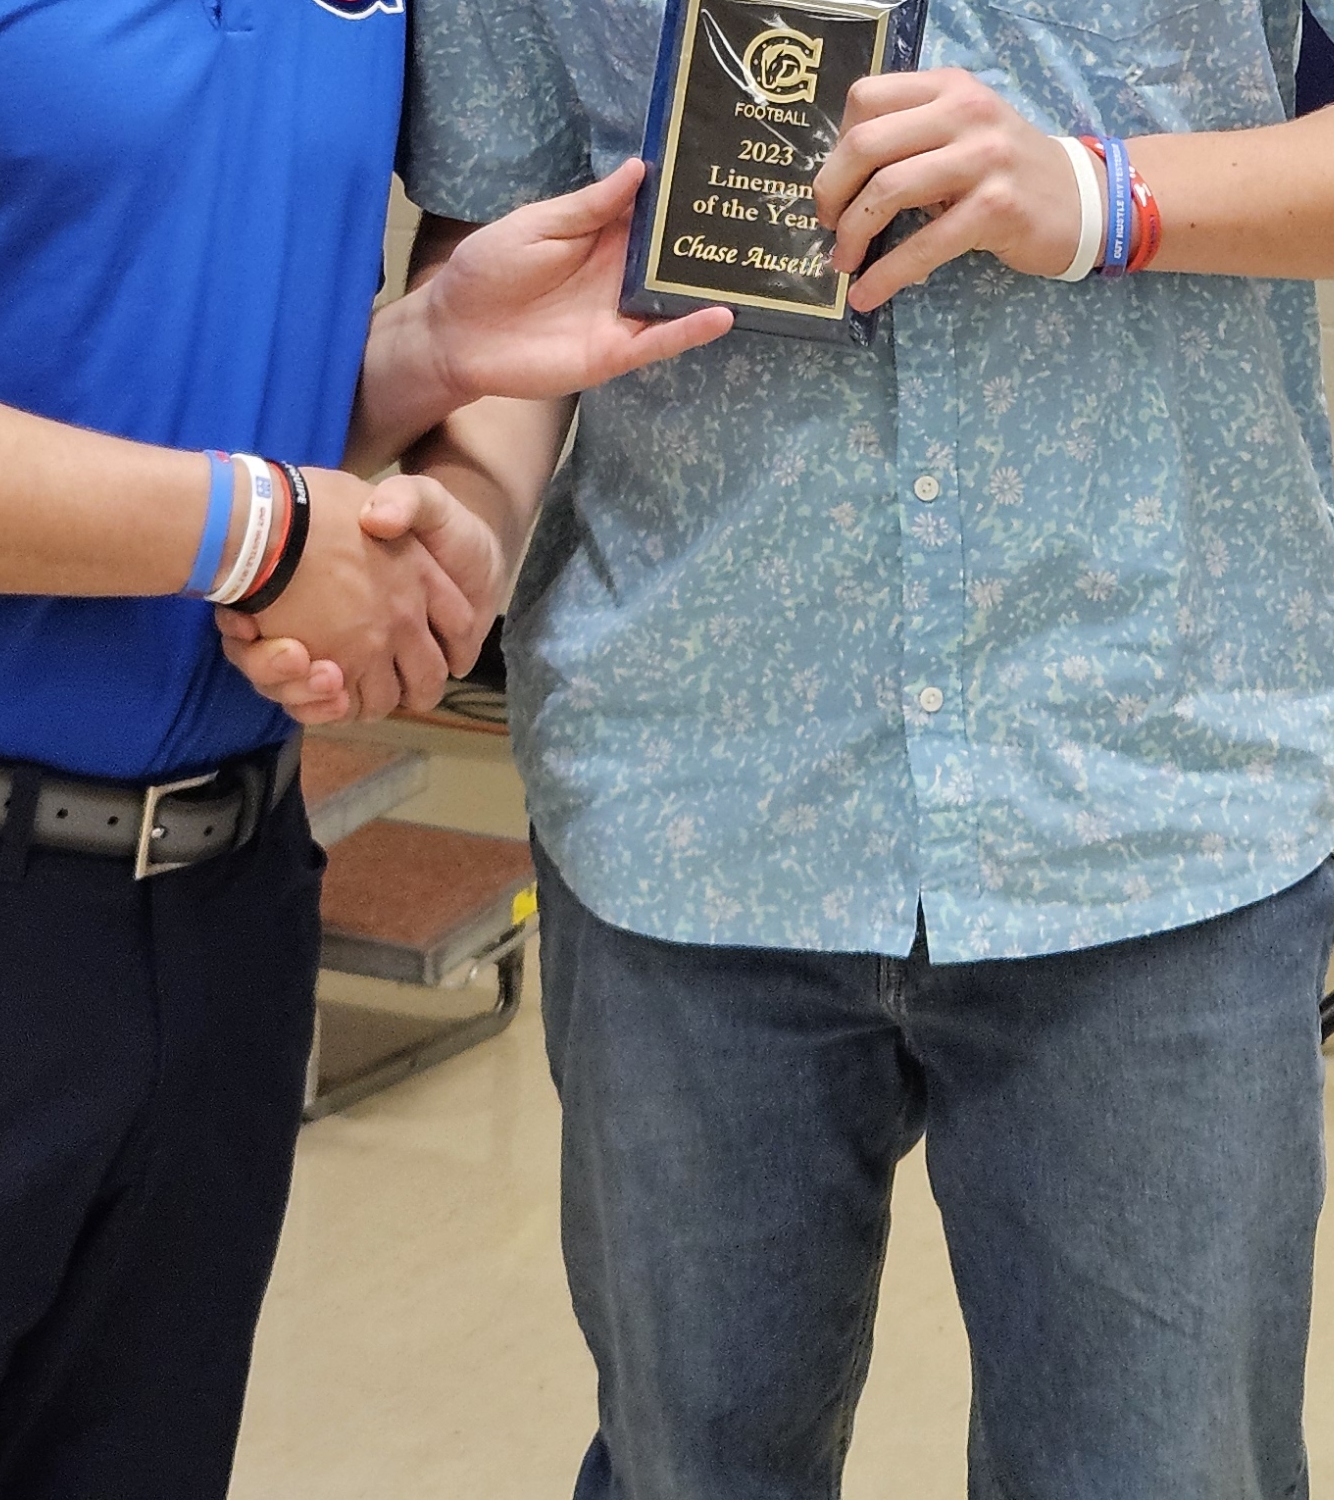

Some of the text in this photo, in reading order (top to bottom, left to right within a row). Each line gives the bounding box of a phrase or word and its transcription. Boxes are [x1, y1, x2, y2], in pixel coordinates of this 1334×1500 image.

[734, 101, 811, 127] FOOTBALL
[737, 139, 795, 166] 2023
[708, 164, 815, 200] Lineman
[692, 194, 820, 231] of the Year
[1115, 199, 1126, 238] HUSTLE
[673, 234, 739, 264] Chase
